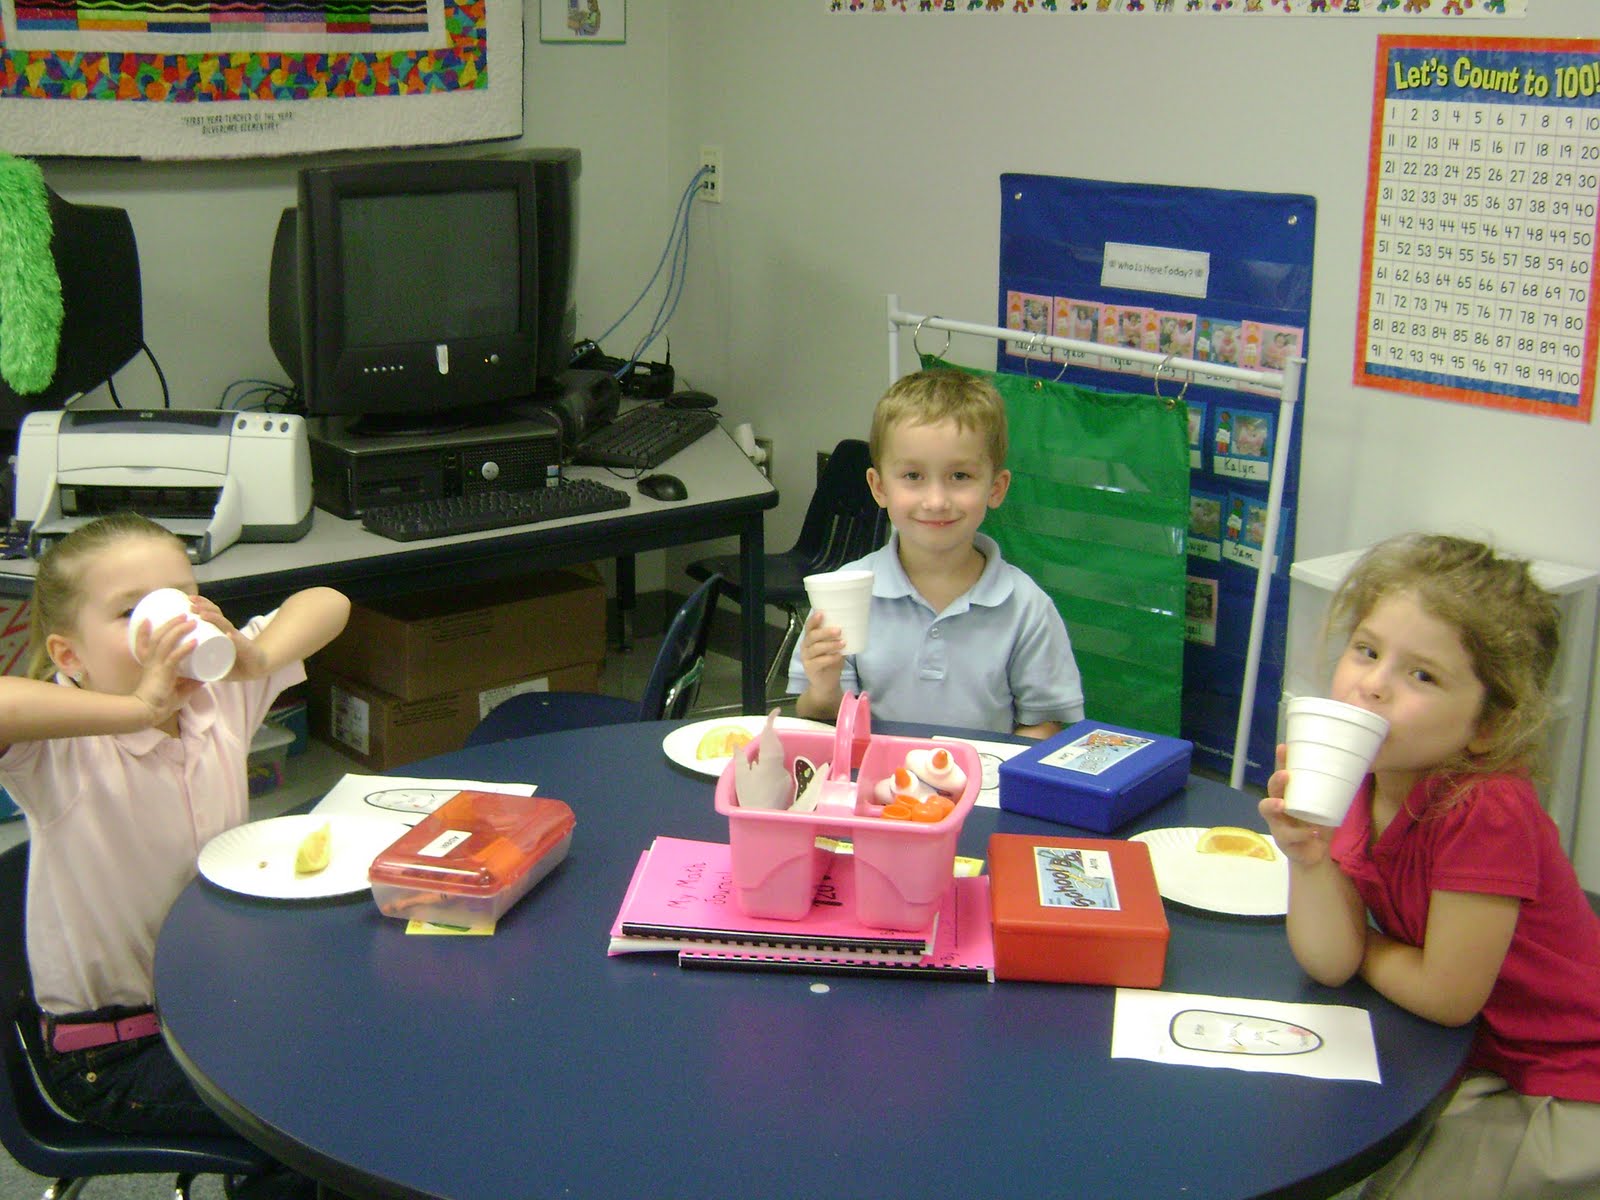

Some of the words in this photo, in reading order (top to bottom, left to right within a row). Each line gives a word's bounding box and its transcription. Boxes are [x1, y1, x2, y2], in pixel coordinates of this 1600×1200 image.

[1394, 57, 1449, 90] Let's
[1453, 56, 1520, 94] Count
[1524, 68, 1549, 98] to
[1555, 61, 1600, 99] 100!
[1411, 108, 1418, 121] 2
[1432, 109, 1440, 122] 3
[1453, 110, 1461, 123] 4
[1475, 111, 1482, 125] 5
[1497, 113, 1504, 126] 6
[1520, 113, 1527, 127] 7
[1541, 115, 1550, 128] 8
[1565, 116, 1573, 129] 9
[1586, 117, 1600, 131] 10
[1388, 134, 1395, 147] 11
[1407, 135, 1418, 149] 12
[1427, 136, 1438, 150] 13
[1448, 138, 1460, 151] 14
[1470, 139, 1481, 152] 15
[1492, 141, 1503, 154] 16
[1514, 141, 1526, 155] 17
[1537, 143, 1549, 157] 18
[1560, 145, 1572, 158] 19
[1581, 146, 1600, 160] 20
[1385, 160, 1395, 173] 21
[1403, 162, 1418, 175] 22
[1424, 163, 1438, 177] 23
[1444, 165, 1459, 178] 24
[1466, 166, 1481, 180] 25
[1488, 168, 1503, 182] 26
[1510, 169, 1526, 183] 27
[1532, 171, 1549, 185] 28
[1555, 173, 1572, 187] 29
[1578, 174, 1597, 189] 30
[1383, 187, 1393, 200] 31
[1401, 189, 1415, 203] 32
[1421, 191, 1436, 204] 33
[1442, 192, 1457, 206] 34
[1464, 194, 1479, 208] 35
[1485, 196, 1500, 210] 36
[1507, 198, 1523, 211] 37
[1530, 200, 1546, 214] 38
[1552, 201, 1569, 215] 39
[1576, 204, 1594, 218] 40
[1380, 214, 1391, 227] 41
[1399, 216, 1413, 229] 42
[1419, 218, 1434, 231] 43
[1440, 220, 1455, 233] 44
[1461, 222, 1477, 235] 45
[1483, 224, 1498, 237] 46
[1505, 226, 1520, 239] 47
[1527, 228, 1543, 242] 48
[1550, 230, 1567, 244] 49
[1573, 232, 1591, 246] 50
[1118, 261, 1134, 271] Who
[1143, 264, 1163, 275] Here
[1165, 265, 1193, 278] Today?
[1379, 240, 1389, 253] 51
[1397, 242, 1411, 256] 52
[1418, 244, 1432, 258] 53
[1438, 246, 1453, 259] 54
[1459, 248, 1474, 262] 55
[1481, 251, 1496, 265] 56
[1503, 253, 1518, 267] 57
[1525, 255, 1541, 269] 58
[1548, 258, 1564, 272] 59
[1570, 260, 1589, 274] 60
[1377, 267, 1387, 279] 61
[1395, 269, 1409, 282] 62
[1415, 271, 1430, 284] 63
[1436, 274, 1451, 286] 64
[1457, 276, 1472, 289] 65
[1479, 278, 1494, 292] 66
[1500, 281, 1516, 294] 67
[1522, 284, 1538, 297] 68
[1545, 286, 1561, 300] 69
[1569, 288, 1586, 303] 70
[1376, 292, 1385, 305] 71
[1394, 294, 1407, 309] 72
[1414, 297, 1428, 311] 73
[1434, 299, 1448, 313] 74
[1456, 302, 1470, 316] 75
[1477, 305, 1491, 319] 76
[1499, 308, 1513, 322] 77
[1520, 311, 1535, 325] 78
[1543, 313, 1558, 327] 79
[1565, 316, 1583, 331] 80
[1373, 318, 1384, 331] 81
[1391, 321, 1406, 335] 82
[1411, 323, 1426, 337] 83
[1432, 326, 1447, 339] 84
[1453, 329, 1468, 343] 85
[1474, 332, 1489, 346] 86
[1496, 335, 1511, 348] 87
[1518, 338, 1534, 352] 88
[1540, 341, 1556, 355] 89
[1563, 344, 1580, 358] 90
[1371, 344, 1381, 357] 91
[1390, 347, 1403, 360] 92
[1410, 350, 1424, 363] 93
[1430, 353, 1444, 366] 94
[1451, 356, 1465, 369] 95
[1472, 359, 1486, 373] 96
[1494, 362, 1508, 375] 97
[1515, 365, 1531, 379] 98
[1538, 368, 1553, 382] 99
[1558, 370, 1580, 387] 100
[1224, 457, 1256, 477] Kalyn
[1232, 546, 1254, 561] Sam
[1046, 868, 1096, 907] School
